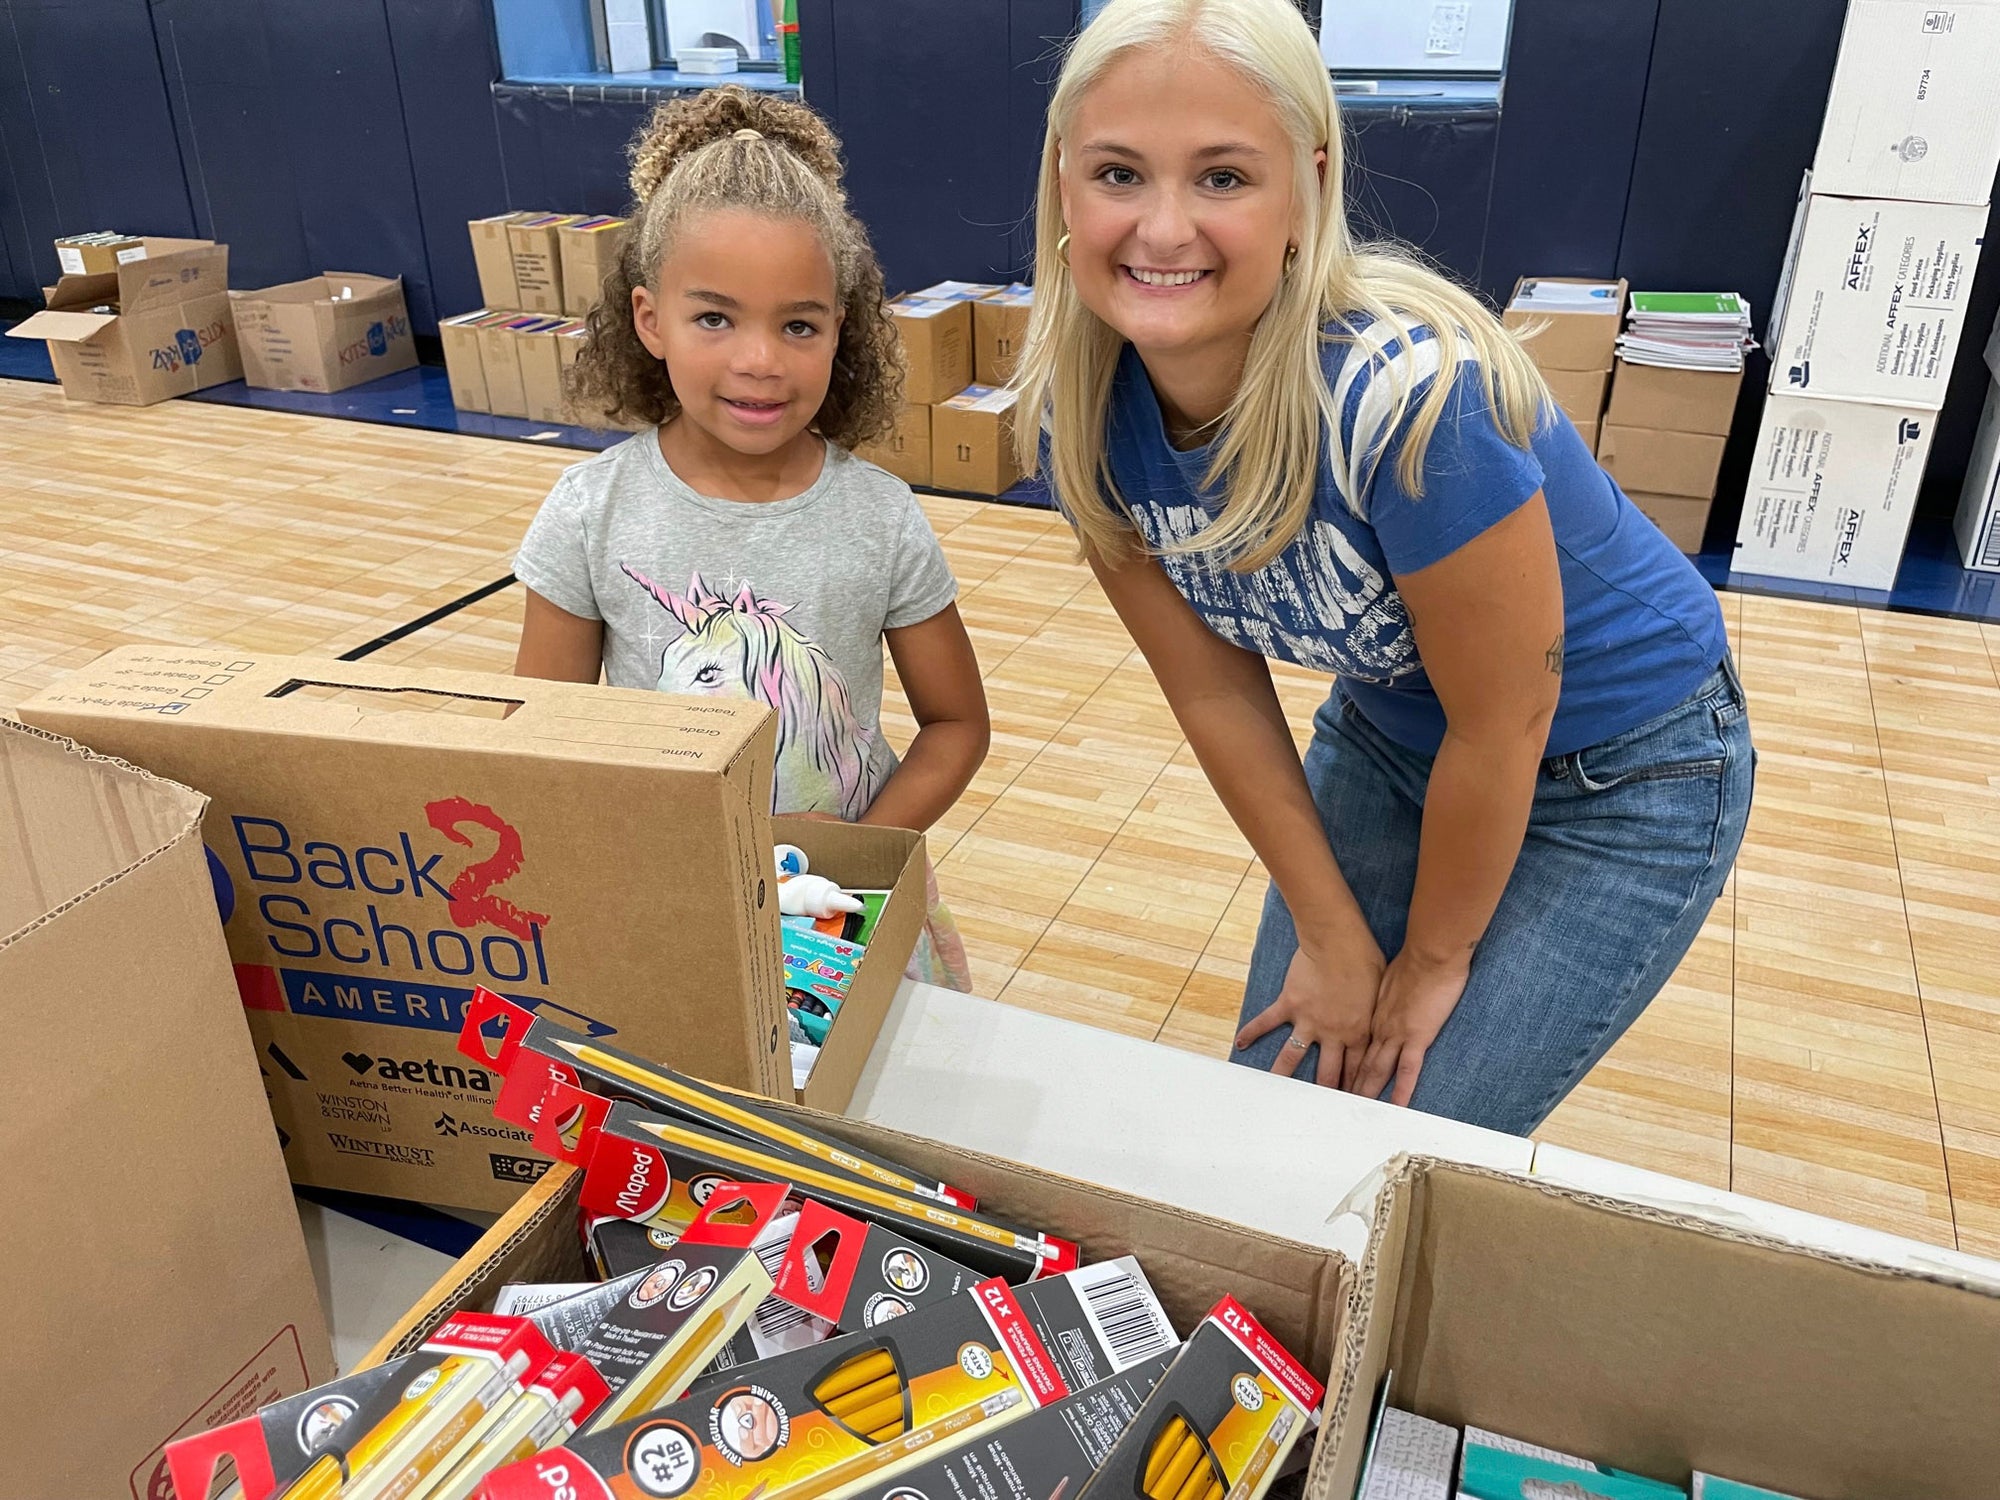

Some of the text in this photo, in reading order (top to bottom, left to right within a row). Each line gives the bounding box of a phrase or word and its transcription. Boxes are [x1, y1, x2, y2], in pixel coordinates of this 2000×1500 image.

[1917, 69, 1931, 100] 857734
[1846, 226, 1870, 290] AFFEX
[1926, 268, 1940, 298] Packaging
[1933, 240, 1946, 266] Supplies
[1947, 253, 1960, 279] Supplies
[1909, 258, 1923, 296] Food Service
[1943, 281, 1954, 299] Safety
[1876, 236, 1914, 373] ADDITIONAL AFFEX CATEGORIES
[1896, 323, 1910, 348] Supplies
[1914, 322, 1927, 347] Supplies
[338, 340, 366, 366] KITS
[1924, 357, 1936, 377] Facility
[1806, 472, 1823, 512] AFFEX
[1837, 509, 1860, 563] AFFEX
[163, 672, 200, 680] Grade
[140, 686, 178, 694] Grade
[118, 700, 156, 708] Grade
[686, 706, 737, 717] Teacher
[680, 726, 720, 737] Grade
[662, 748, 703, 760] Name
[231, 795, 551, 942] Back 2
[258, 894, 550, 986] School
[316, 1092, 388, 1112] WINSTON
[350, 1080, 378, 1090] Aetna
[382, 1084, 412, 1095] Better
[454, 1093, 464, 1101] of
[466, 1094, 498, 1106] Illinoi
[327, 1132, 434, 1162] WINTRUST
[389, 1155, 416, 1164] BANK
[615, 1149, 653, 1214] Maped
[872, 1169, 900, 1186] Maped
[971, 1224, 1000, 1239] Maped
[860, 1293, 886, 1326] RIANGULAR
[983, 1286, 1013, 1317] x12
[1222, 1307, 1252, 1337] x12
[960, 1356, 974, 1375] SANS
[967, 1348, 985, 1376] LATEX
[979, 1350, 992, 1367] FREE
[1007, 1326, 1047, 1394] GRAPHITE PENCILS
[1012, 1320, 1054, 1391] CRAYONS GRAPHITE
[1256, 1336, 1314, 1394] CRAYONS GRAPHITE
[1255, 1344, 1311, 1400] GRAPHITE PENCILS
[220, 1373, 261, 1409] corrugated
[1235, 1392, 1252, 1409] SANS
[1236, 1382, 1260, 1405] LATEX
[750, 1384, 790, 1446] TRIANGULAIRE
[708, 1406, 742, 1467] TRIANGULAR
[1095, 1419, 1112, 1444] MAPED
[642, 1442, 674, 1482] #2
[668, 1440, 690, 1470] HB
[961, 1455, 977, 1477] Mines
[986, 1443, 1001, 1465] Minas
[945, 1468, 959, 1489] leads
[974, 1464, 998, 1500] Fabriqué
[1000, 1451, 1024, 1490] Fabricado
[1001, 1470, 1016, 1492] mano
